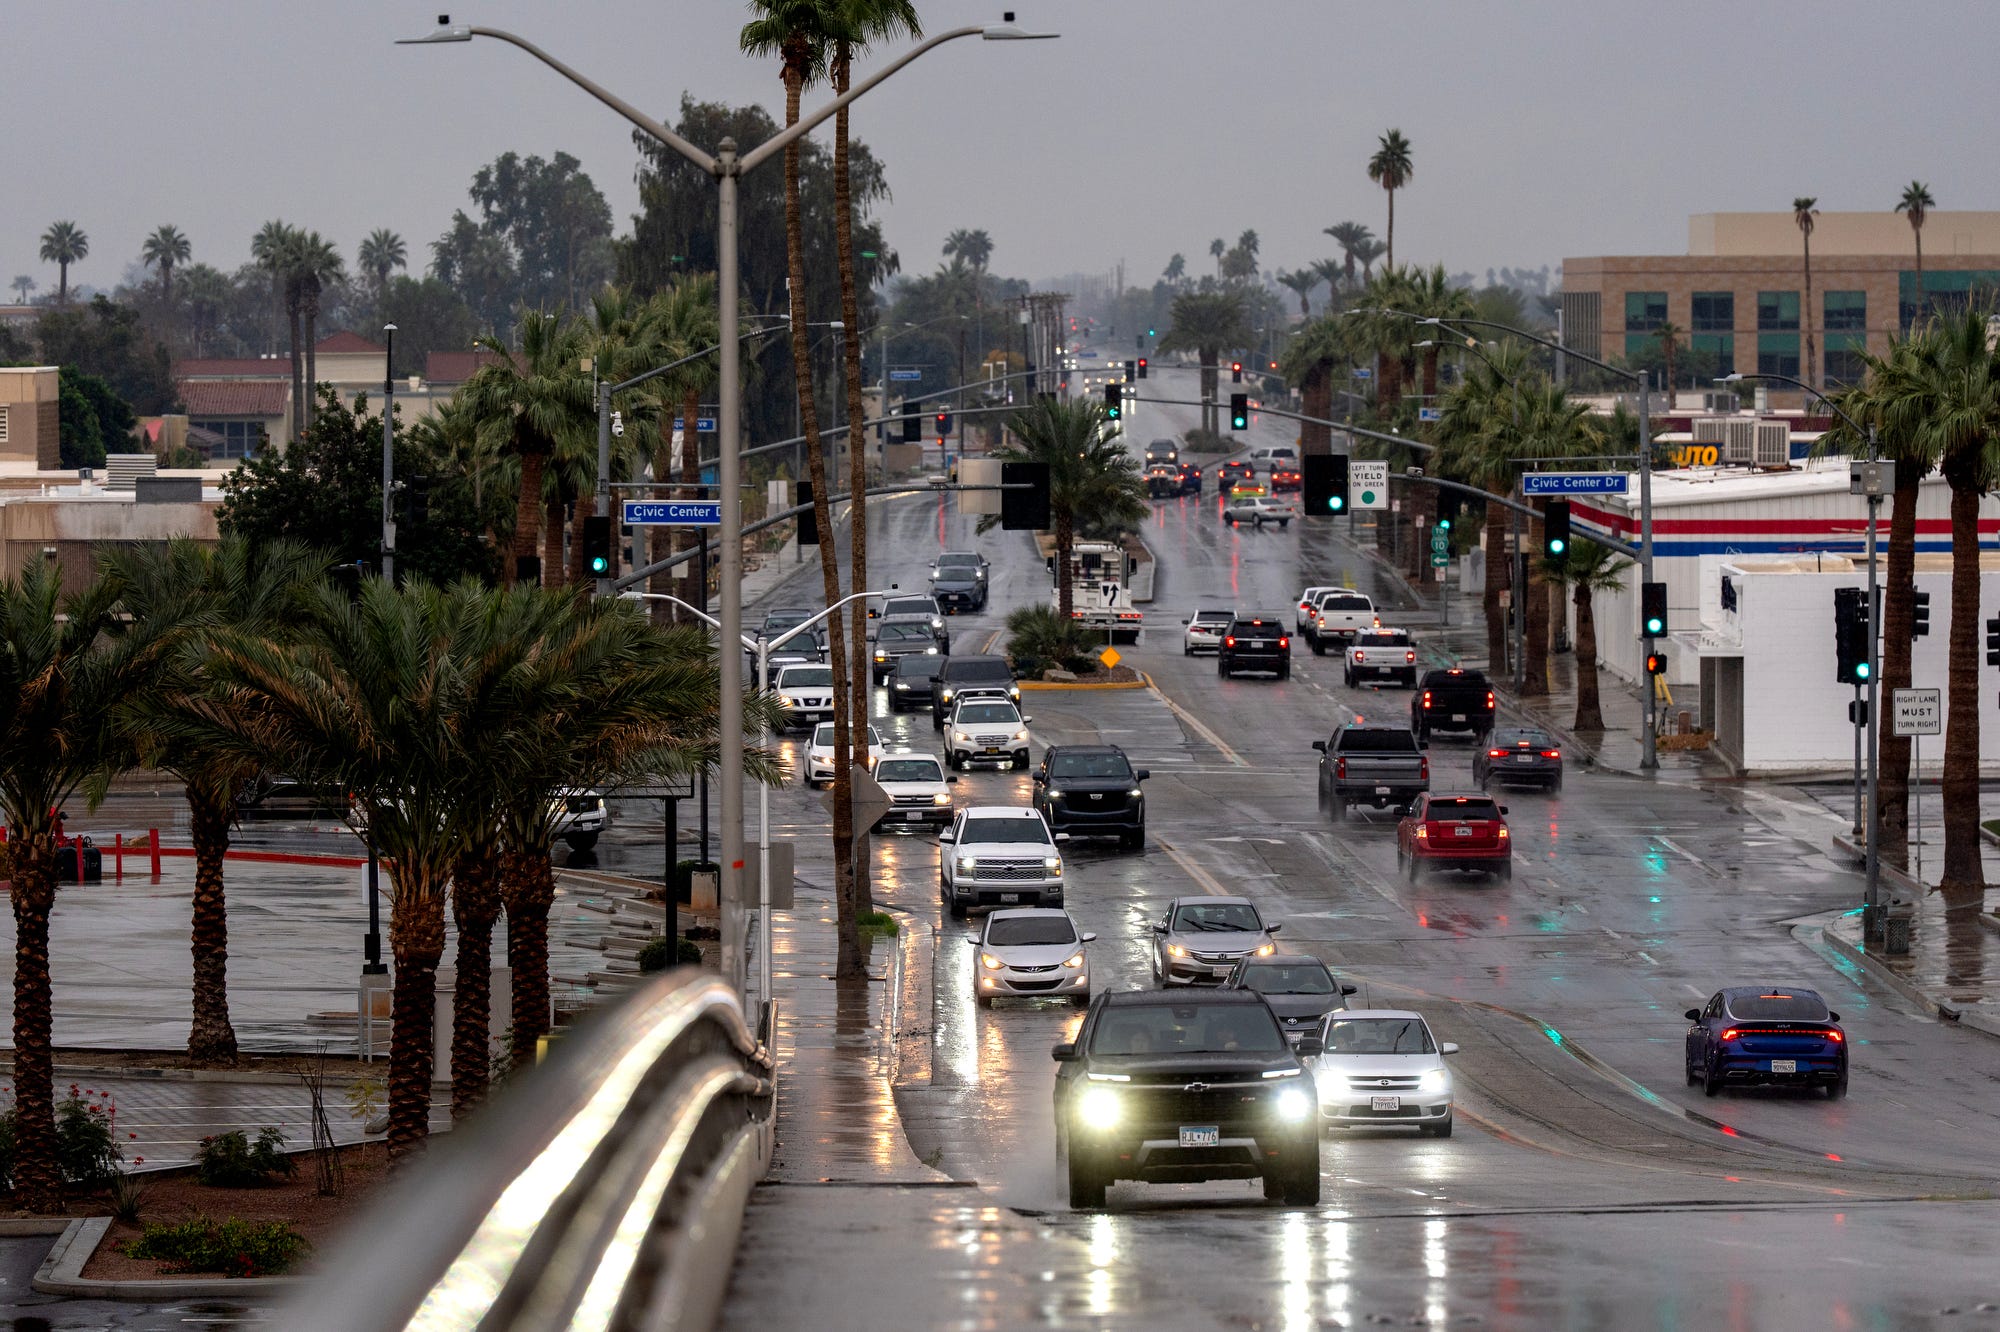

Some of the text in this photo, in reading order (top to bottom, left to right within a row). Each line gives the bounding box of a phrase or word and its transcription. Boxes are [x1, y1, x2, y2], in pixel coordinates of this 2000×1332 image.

[1353, 472, 1383, 480] YIELD
[1531, 476, 1620, 488] Civic Center Dr
[633, 505, 664, 517] Civic
[669, 505, 711, 517] Center
[1435, 541, 1445, 550] 10
[1918, 695, 1938, 703] LANE
[1901, 707, 1933, 717] MUST
[1896, 720, 1938, 728] TURN RIGHT
